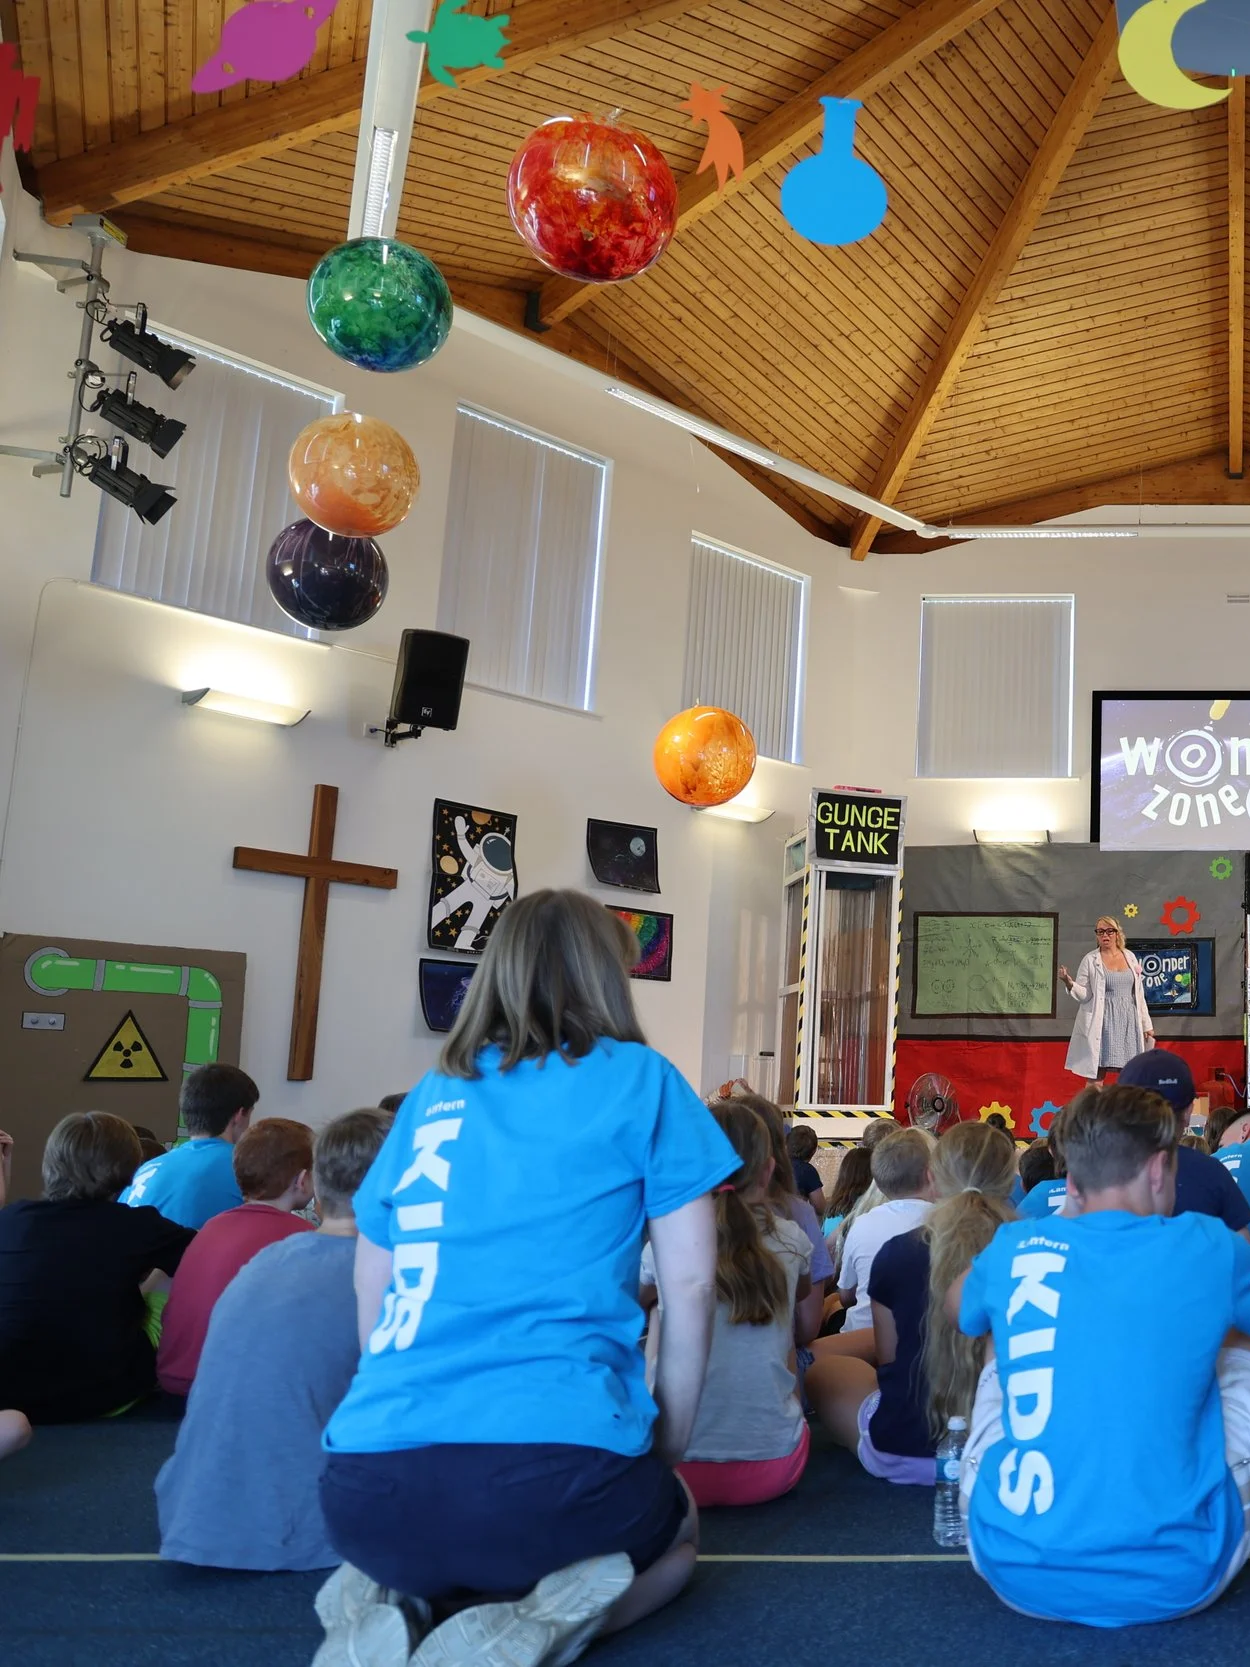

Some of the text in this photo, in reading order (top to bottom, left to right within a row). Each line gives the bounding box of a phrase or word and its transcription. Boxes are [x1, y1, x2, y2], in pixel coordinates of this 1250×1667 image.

[817, 801, 900, 831] GUNGE
[824, 827, 890, 855] TANK
[369, 1118, 463, 1354] KIDS
[998, 1252, 1067, 1516] KIDS
